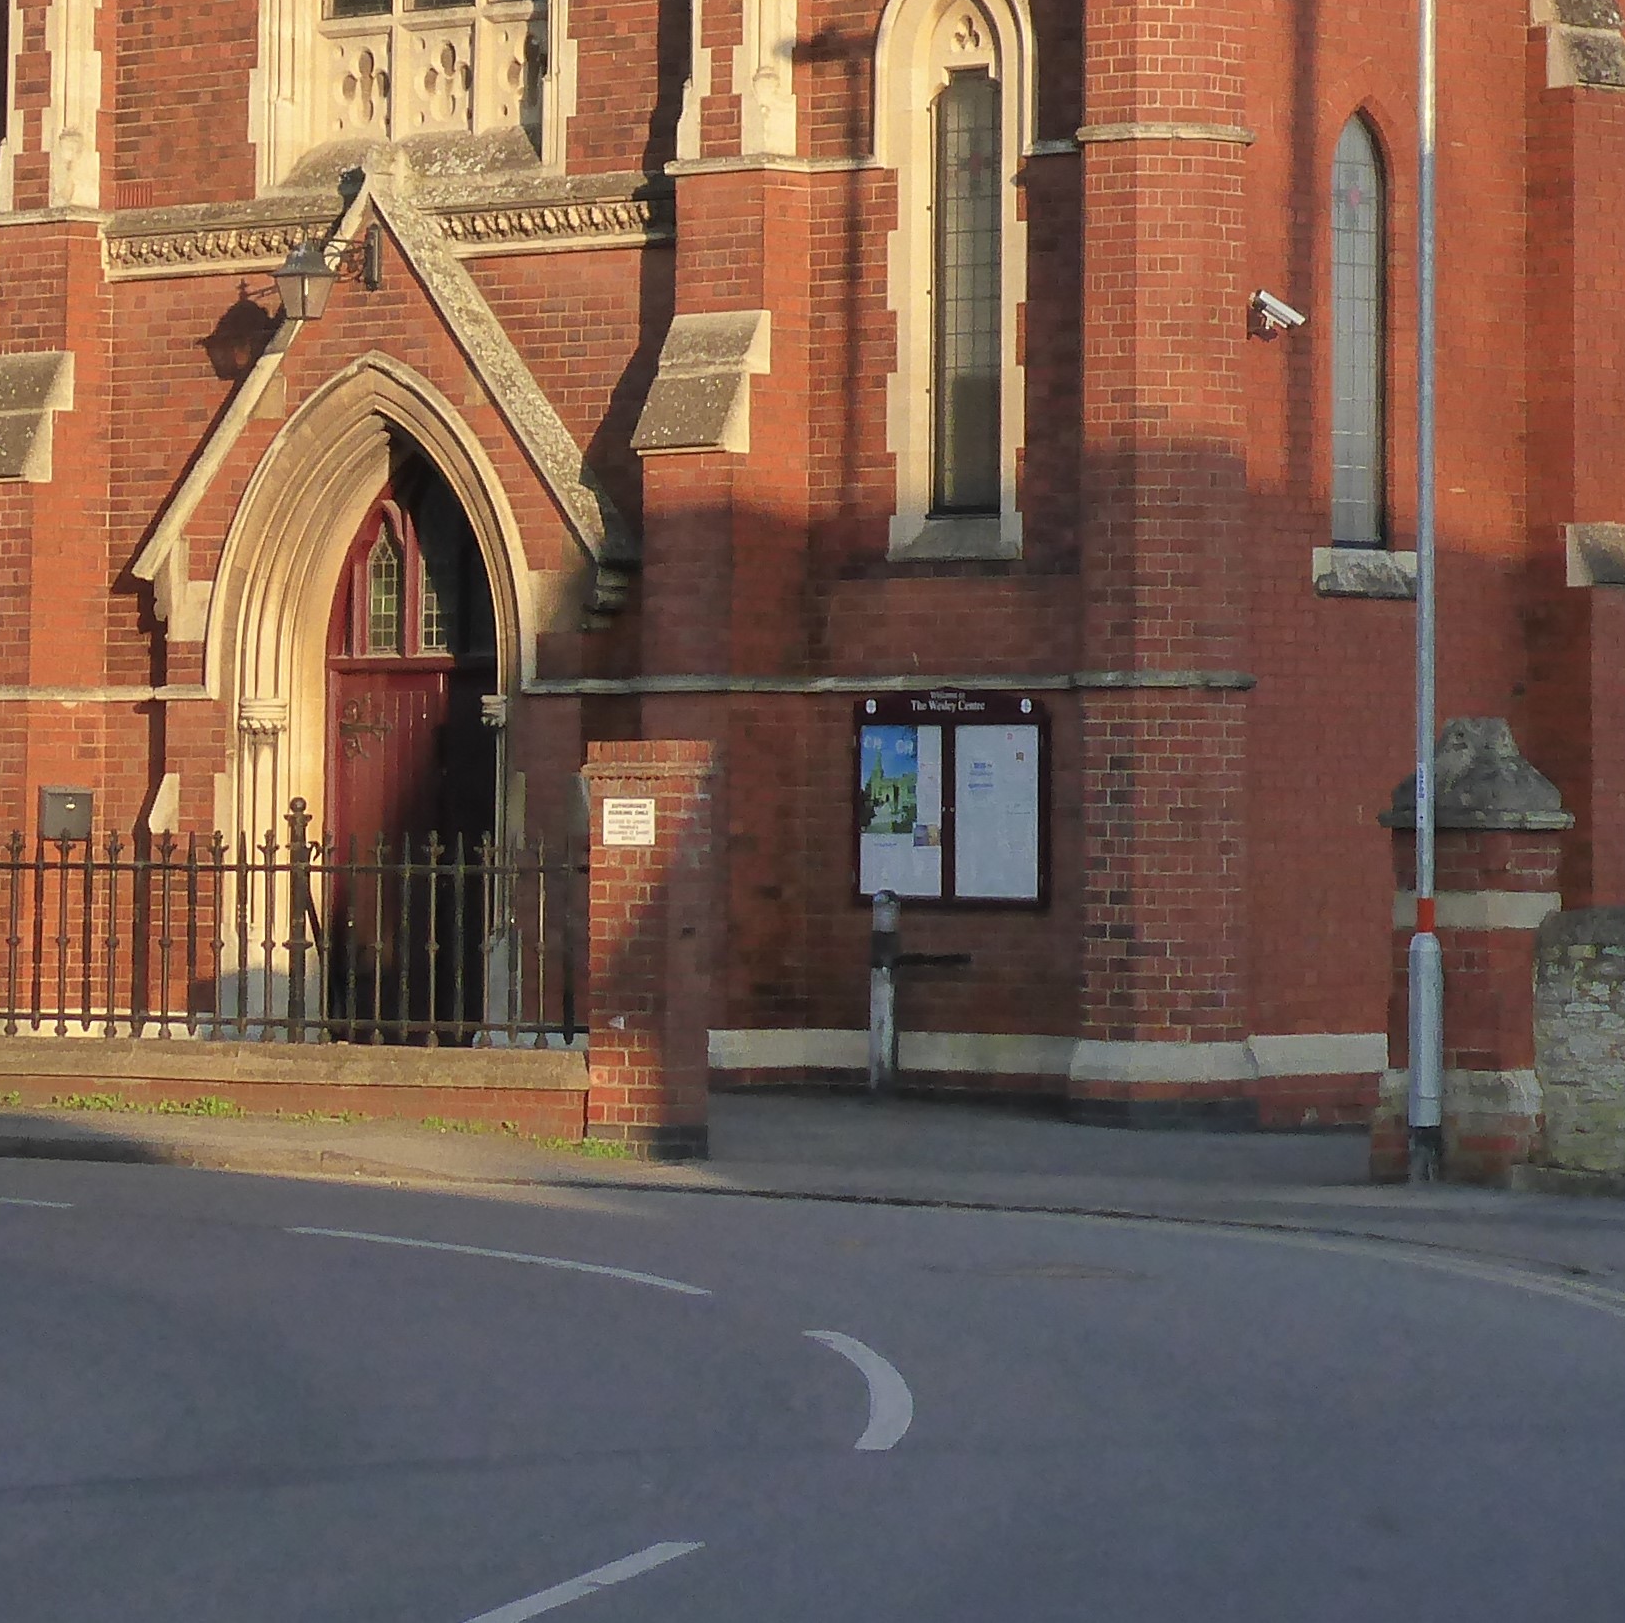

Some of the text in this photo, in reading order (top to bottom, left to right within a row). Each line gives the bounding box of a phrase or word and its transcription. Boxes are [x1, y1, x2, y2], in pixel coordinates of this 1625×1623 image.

[910, 699, 986, 713] The Wesley Centre
